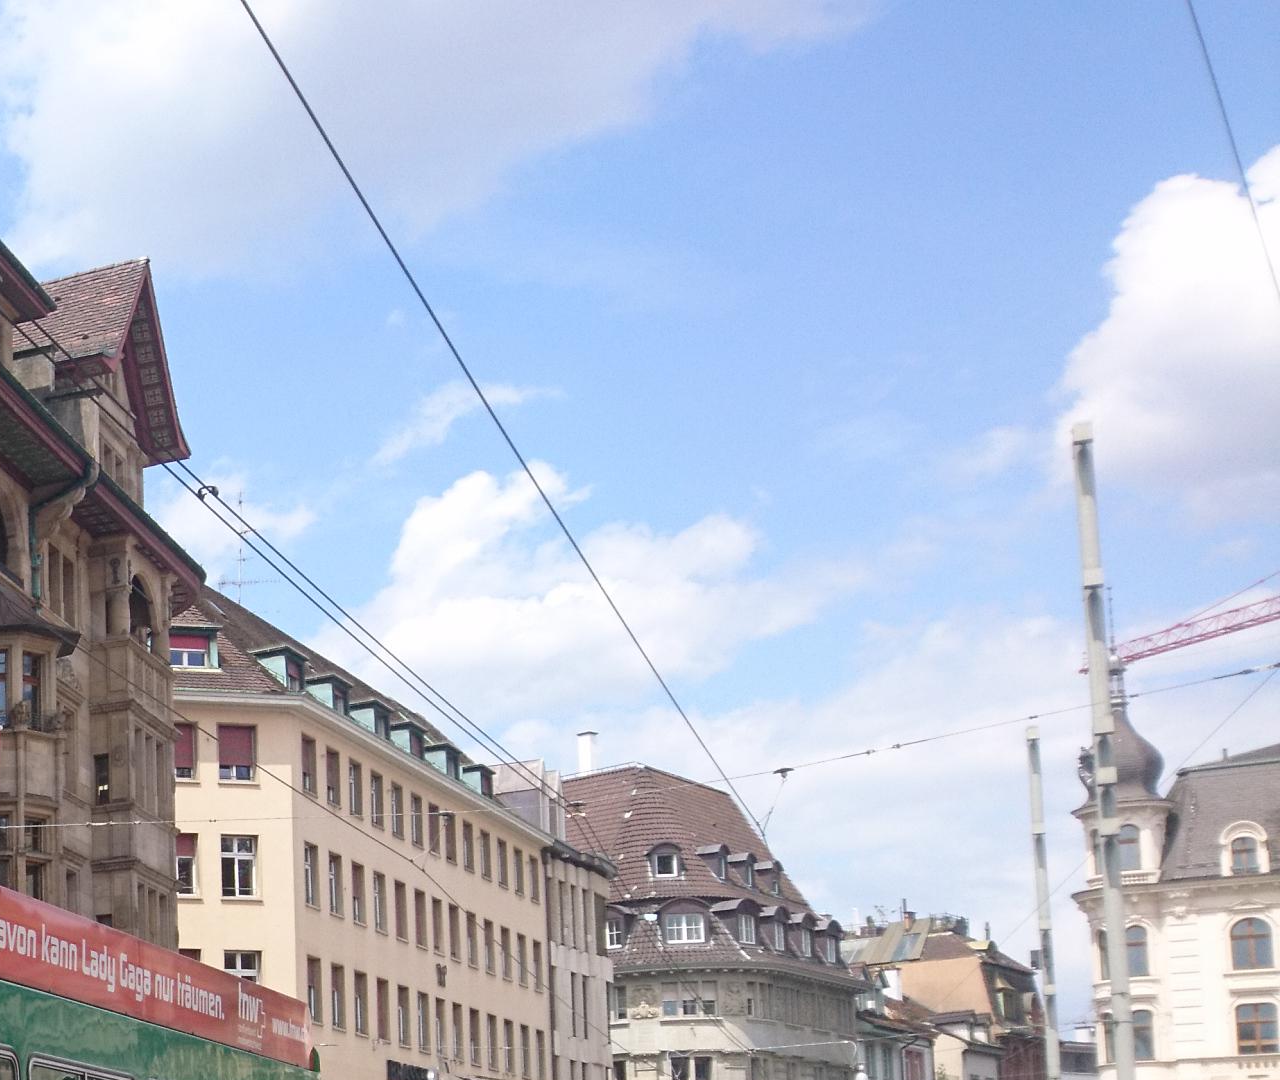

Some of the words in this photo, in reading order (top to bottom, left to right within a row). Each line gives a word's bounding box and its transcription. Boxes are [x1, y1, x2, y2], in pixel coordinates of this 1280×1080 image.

[41, 923, 78, 971] kann
[82, 938, 115, 993] Lady
[119, 953, 151, 1002] Gaga
[155, 974, 174, 1004] nur
[177, 973, 225, 1021] träumen.
